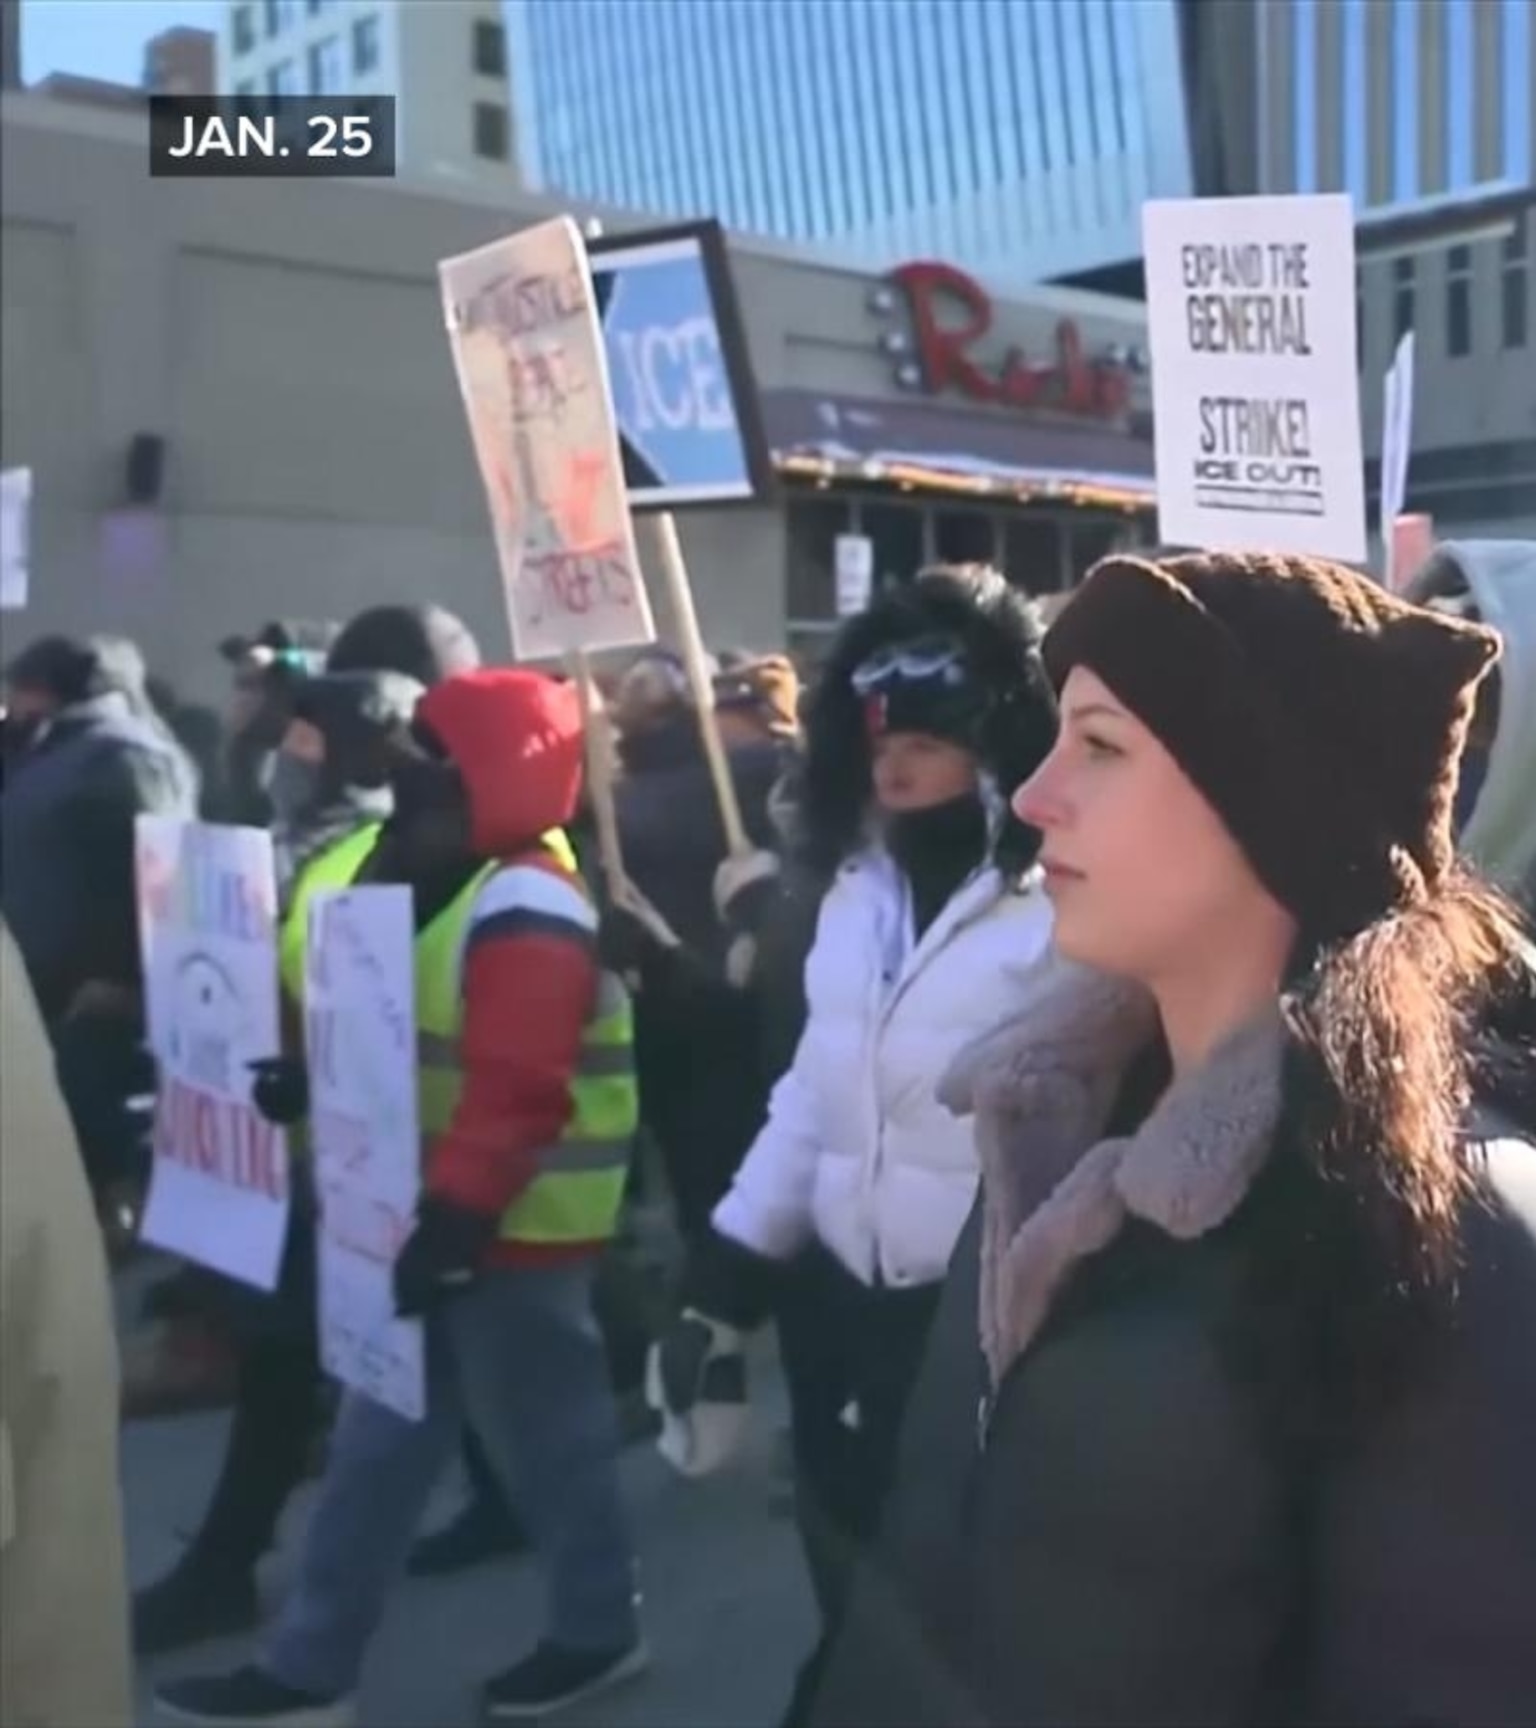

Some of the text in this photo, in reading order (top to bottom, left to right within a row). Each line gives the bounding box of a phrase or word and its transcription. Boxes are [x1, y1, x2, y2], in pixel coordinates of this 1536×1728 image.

[1181, 243, 1309, 288] EXPAND THE
[1186, 295, 1311, 355] GENERAL
[617, 318, 733, 430] ICE
[1194, 460, 1239, 480] ICE
